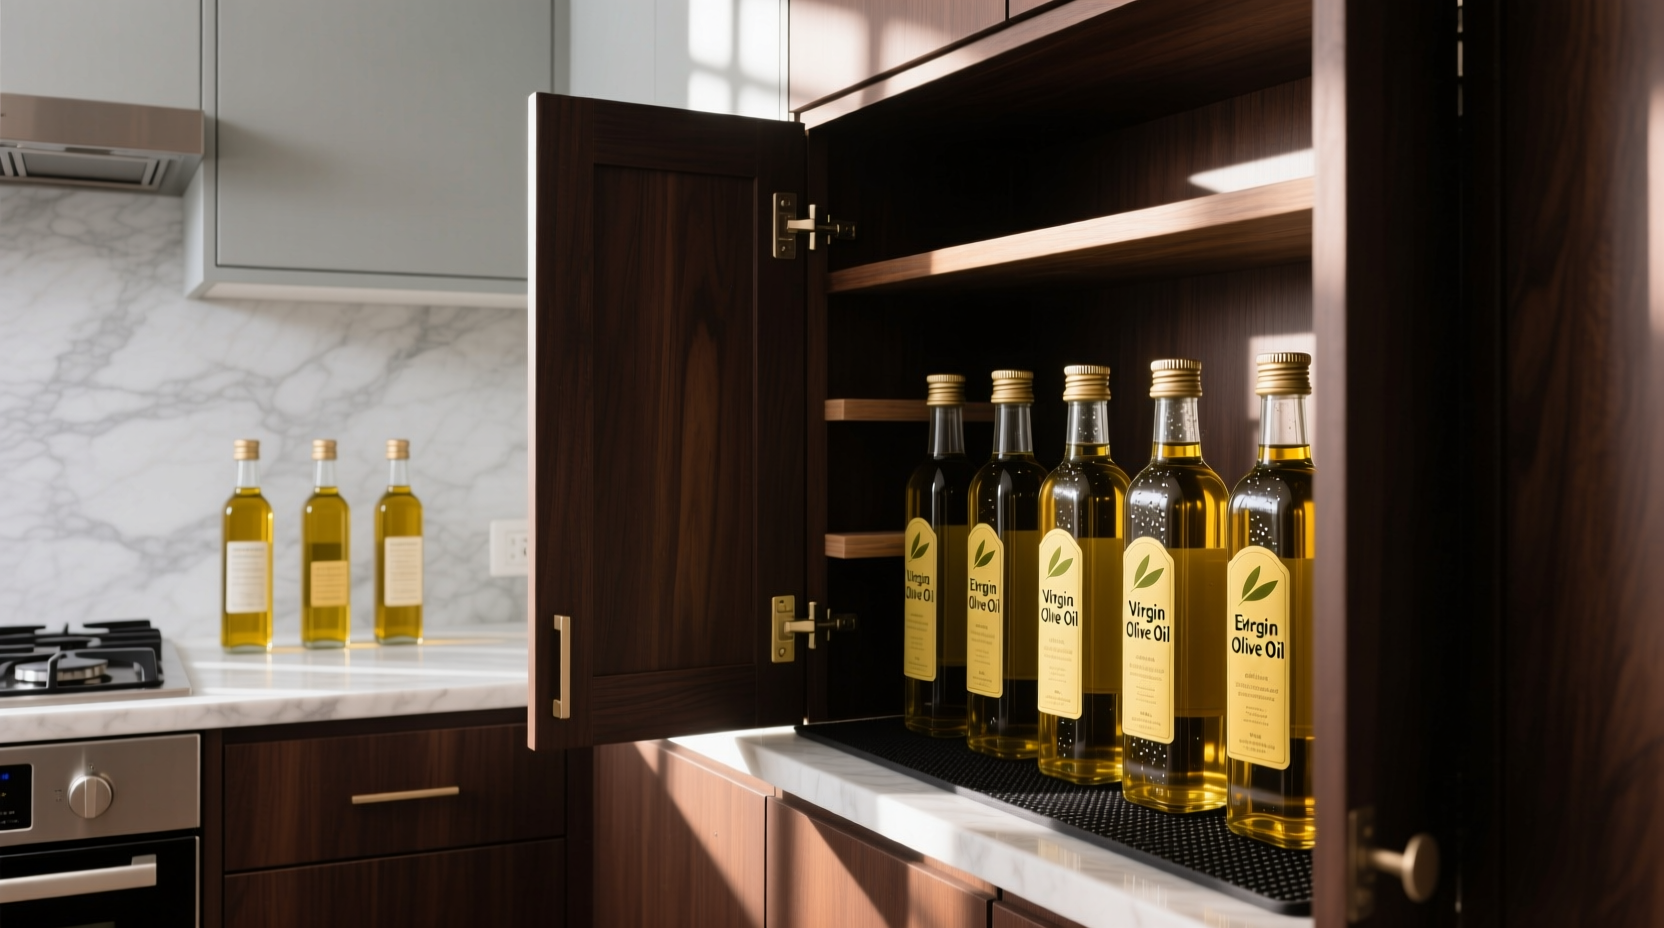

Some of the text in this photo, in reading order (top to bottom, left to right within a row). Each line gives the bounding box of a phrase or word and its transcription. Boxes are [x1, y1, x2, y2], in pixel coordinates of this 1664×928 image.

[987, 598, 1000, 613] Oil
[1128, 600, 1165, 623] Virgin
[1063, 610, 1078, 626] Oil
[1126, 621, 1170, 642] Olive Oil
[1231, 636, 1284, 659] Olive Oil
